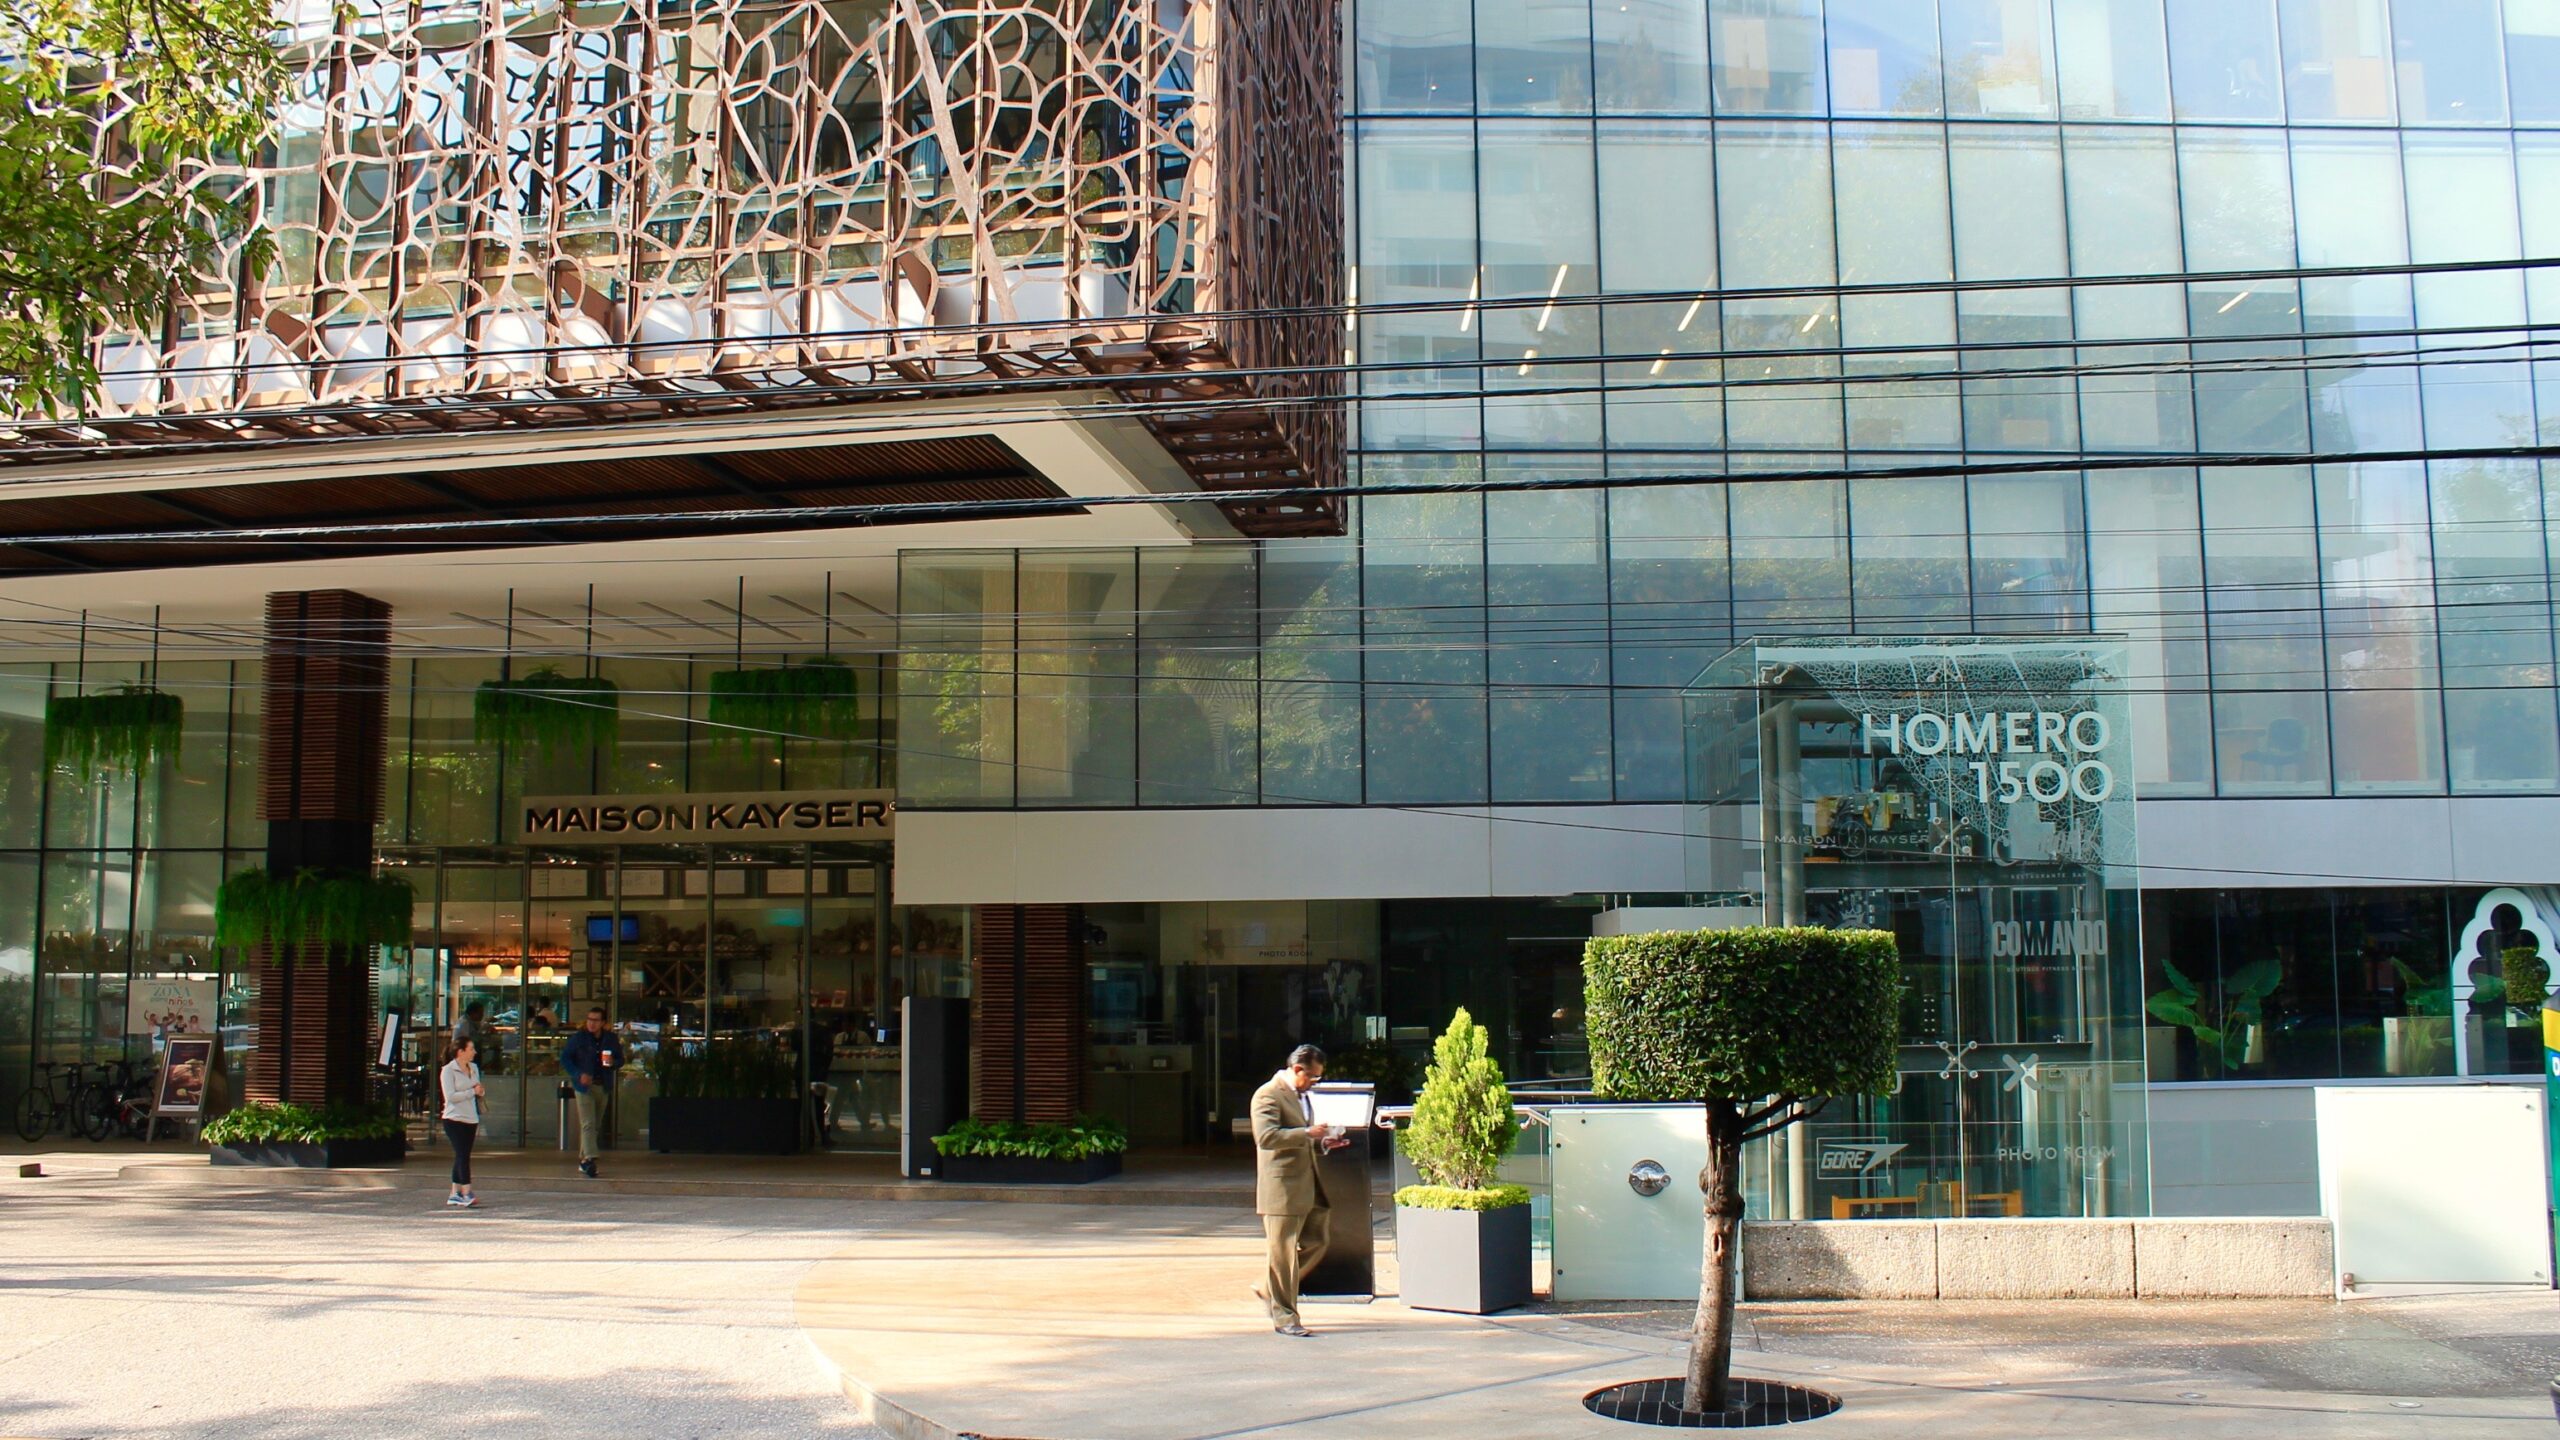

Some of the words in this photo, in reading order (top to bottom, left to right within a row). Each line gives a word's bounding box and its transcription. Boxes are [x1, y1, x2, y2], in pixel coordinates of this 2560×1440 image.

[1863, 711, 2110, 755] HOMERO
[1969, 760, 2113, 803] 1500
[526, 805, 696, 833] MAISON
[1774, 834, 1836, 845] MAISON
[1868, 834, 1930, 844] KAYSER
[1992, 920, 2107, 957] COMMANDO
[1821, 1151, 1867, 1170] GORE
